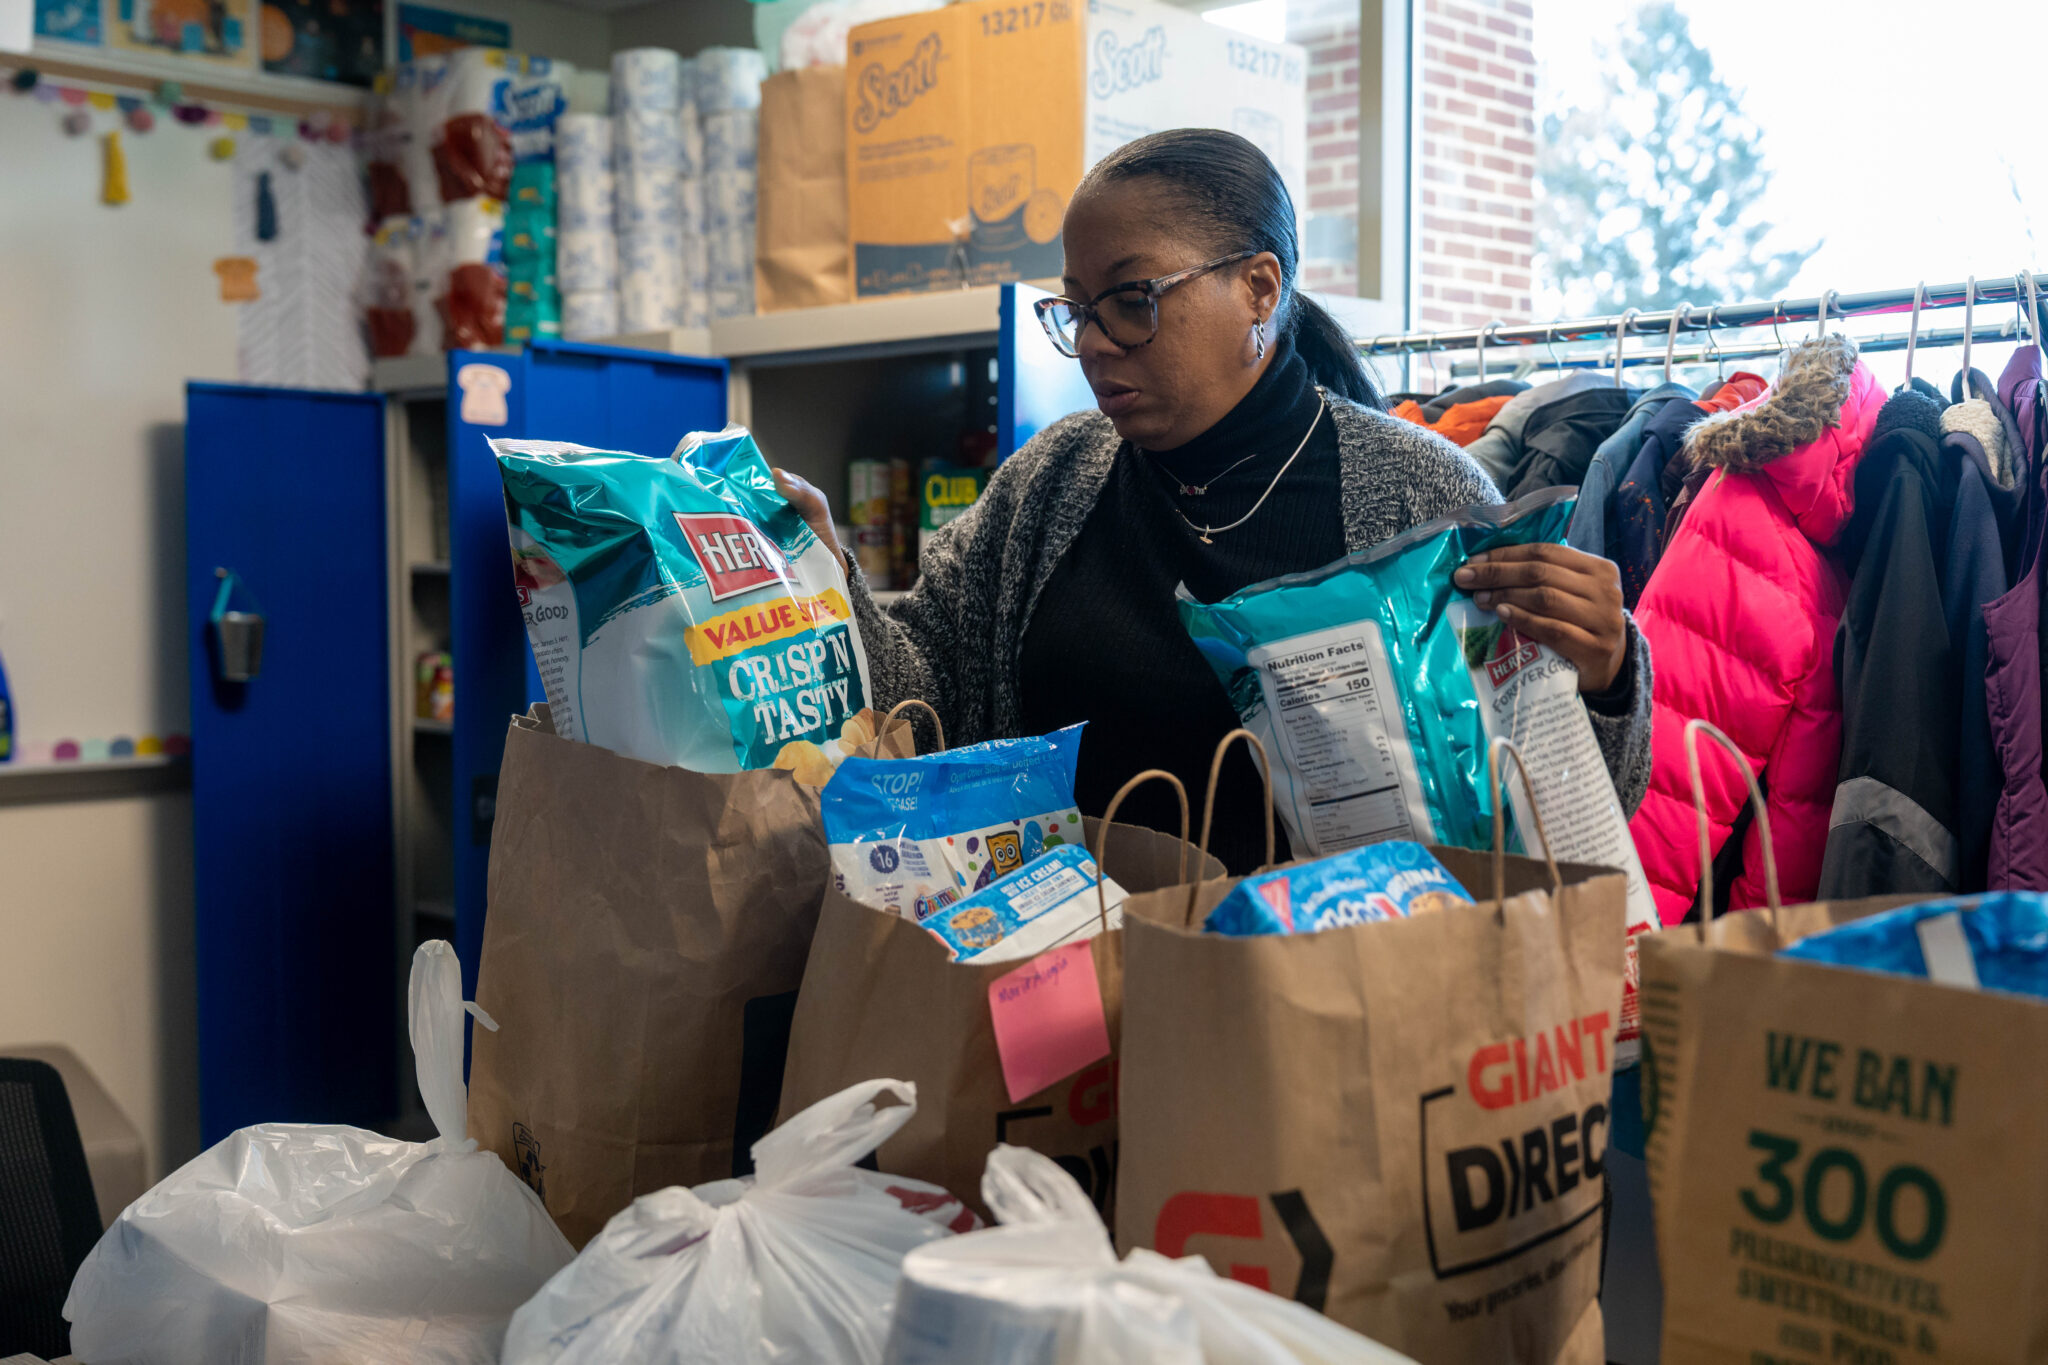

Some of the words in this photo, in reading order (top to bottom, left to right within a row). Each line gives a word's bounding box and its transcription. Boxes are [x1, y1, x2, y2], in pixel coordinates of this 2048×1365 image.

[982, 2, 1045, 36] 13217
[1089, 24, 1167, 101] Scott
[1226, 40, 1281, 80] 13217
[853, 31, 943, 135] Scott
[925, 474, 978, 508] CLUB
[535, 604, 569, 624] GOOD
[703, 604, 796, 650] VALUE
[1267, 651, 1325, 672] Nutrition
[1326, 641, 1364, 657] Facts
[1279, 691, 1321, 707] Calories
[1345, 677, 1371, 691] 150
[1492, 666, 1550, 713] FOREVER
[753, 677, 854, 745] TASTY
[1012, 756, 1038, 769] Dotted
[872, 771, 925, 796] STOP!
[878, 851, 894, 869] 16
[1552, 843, 1575, 856] making
[1016, 876, 1035, 891] ICE
[1030, 859, 1065, 882] CREAM!
[1467, 1010, 1613, 1112] GIANT
[1765, 1029, 1842, 1100] WE
[1853, 1045, 1958, 1126] BAN
[1447, 1103, 1610, 1233] DIREC
[1739, 1128, 1948, 1263] 300
